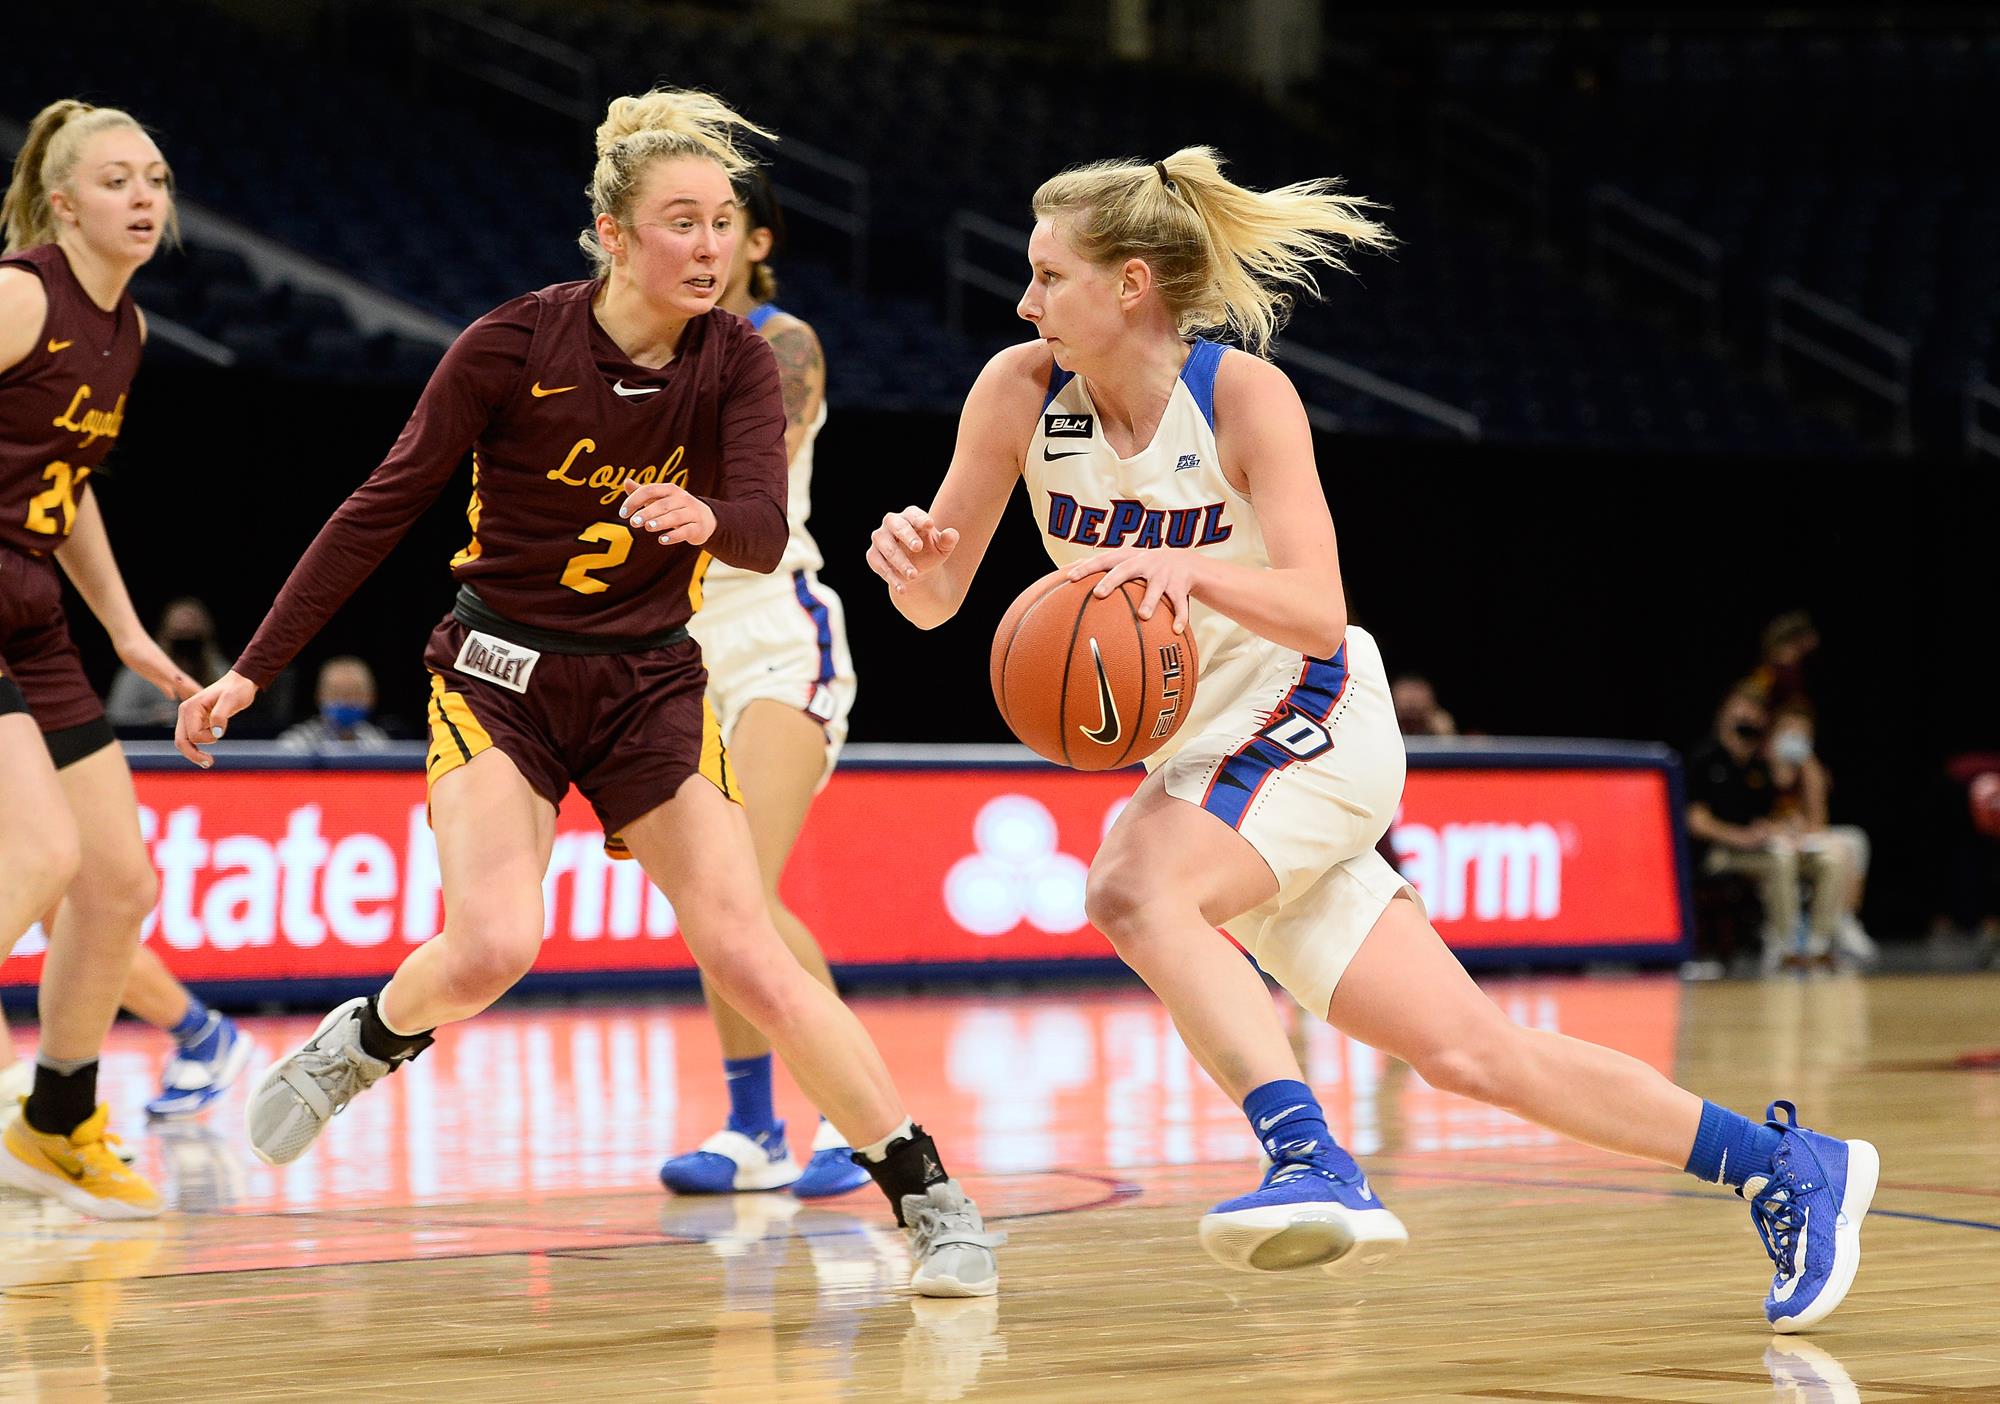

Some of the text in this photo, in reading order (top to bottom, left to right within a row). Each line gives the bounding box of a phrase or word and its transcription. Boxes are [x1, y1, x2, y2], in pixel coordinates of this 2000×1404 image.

[53, 384, 126, 448] Loyol
[1051, 418, 1088, 430] BLM
[1176, 459, 1201, 469] EAST
[1179, 454, 1197, 462] BIG
[559, 521, 634, 595] 2
[463, 637, 533, 687] VALLEY
[1150, 643, 1180, 739] ELITE
[1252, 699, 1335, 762] D
